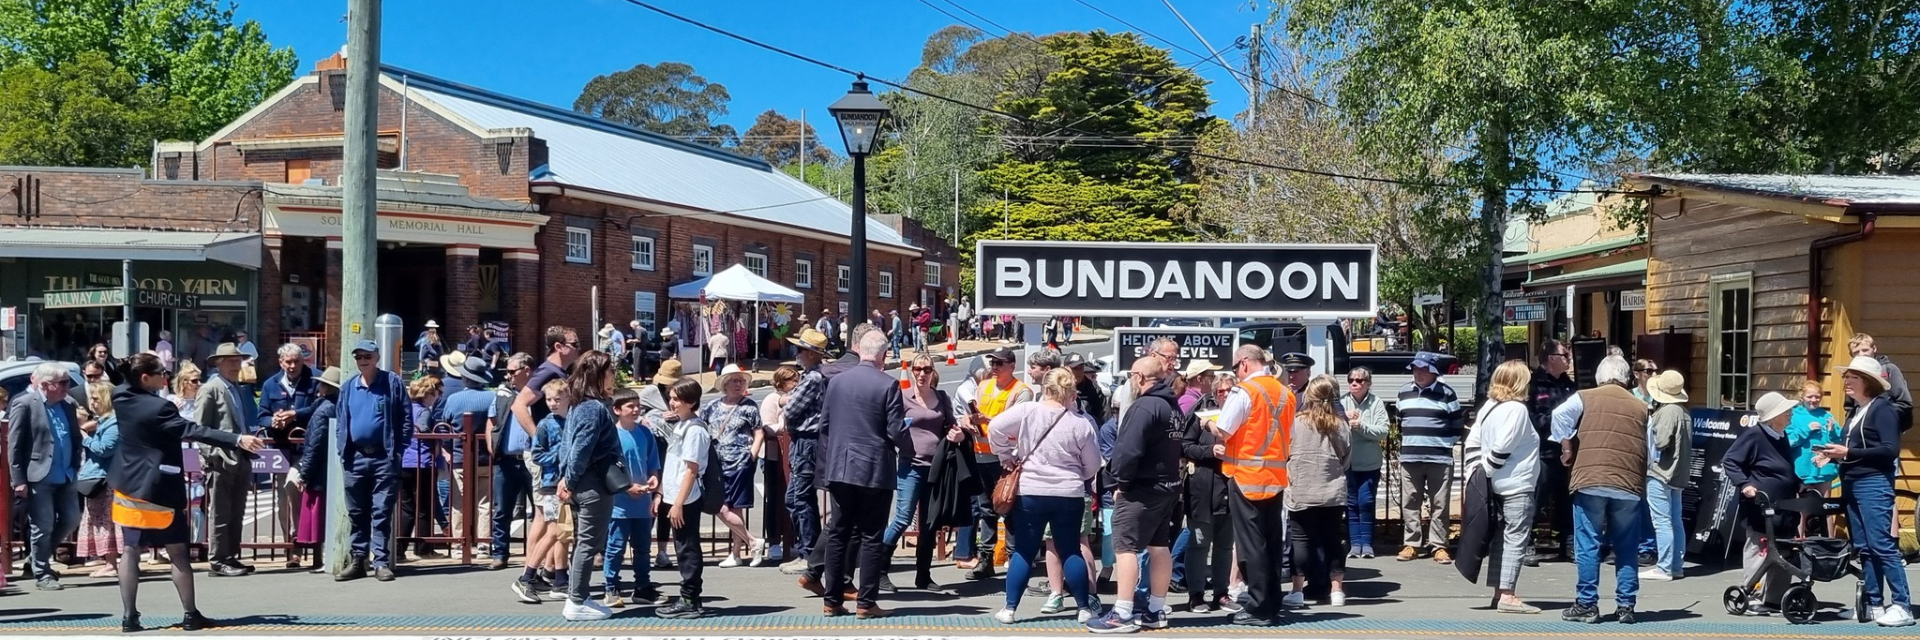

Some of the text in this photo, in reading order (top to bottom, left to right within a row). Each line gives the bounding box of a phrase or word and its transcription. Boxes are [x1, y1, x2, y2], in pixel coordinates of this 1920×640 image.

[389, 219, 448, 232] MEMORIAL
[457, 224, 484, 235] HALL
[45, 276, 79, 291] TH
[180, 278, 237, 295] YARN
[995, 257, 1358, 300] BUNDANOON
[45, 289, 121, 307] RAILWAY AVE
[139, 290, 199, 309] CHURCH ST
[1622, 294, 1646, 306] HAIRDR
[1515, 311, 1545, 320] REAL ESTATE
[1183, 335, 1231, 346] ABOVE
[1177, 347, 1219, 358] EVEL
[1693, 418, 1730, 430] Welcome
[272, 455, 282, 469] 2
